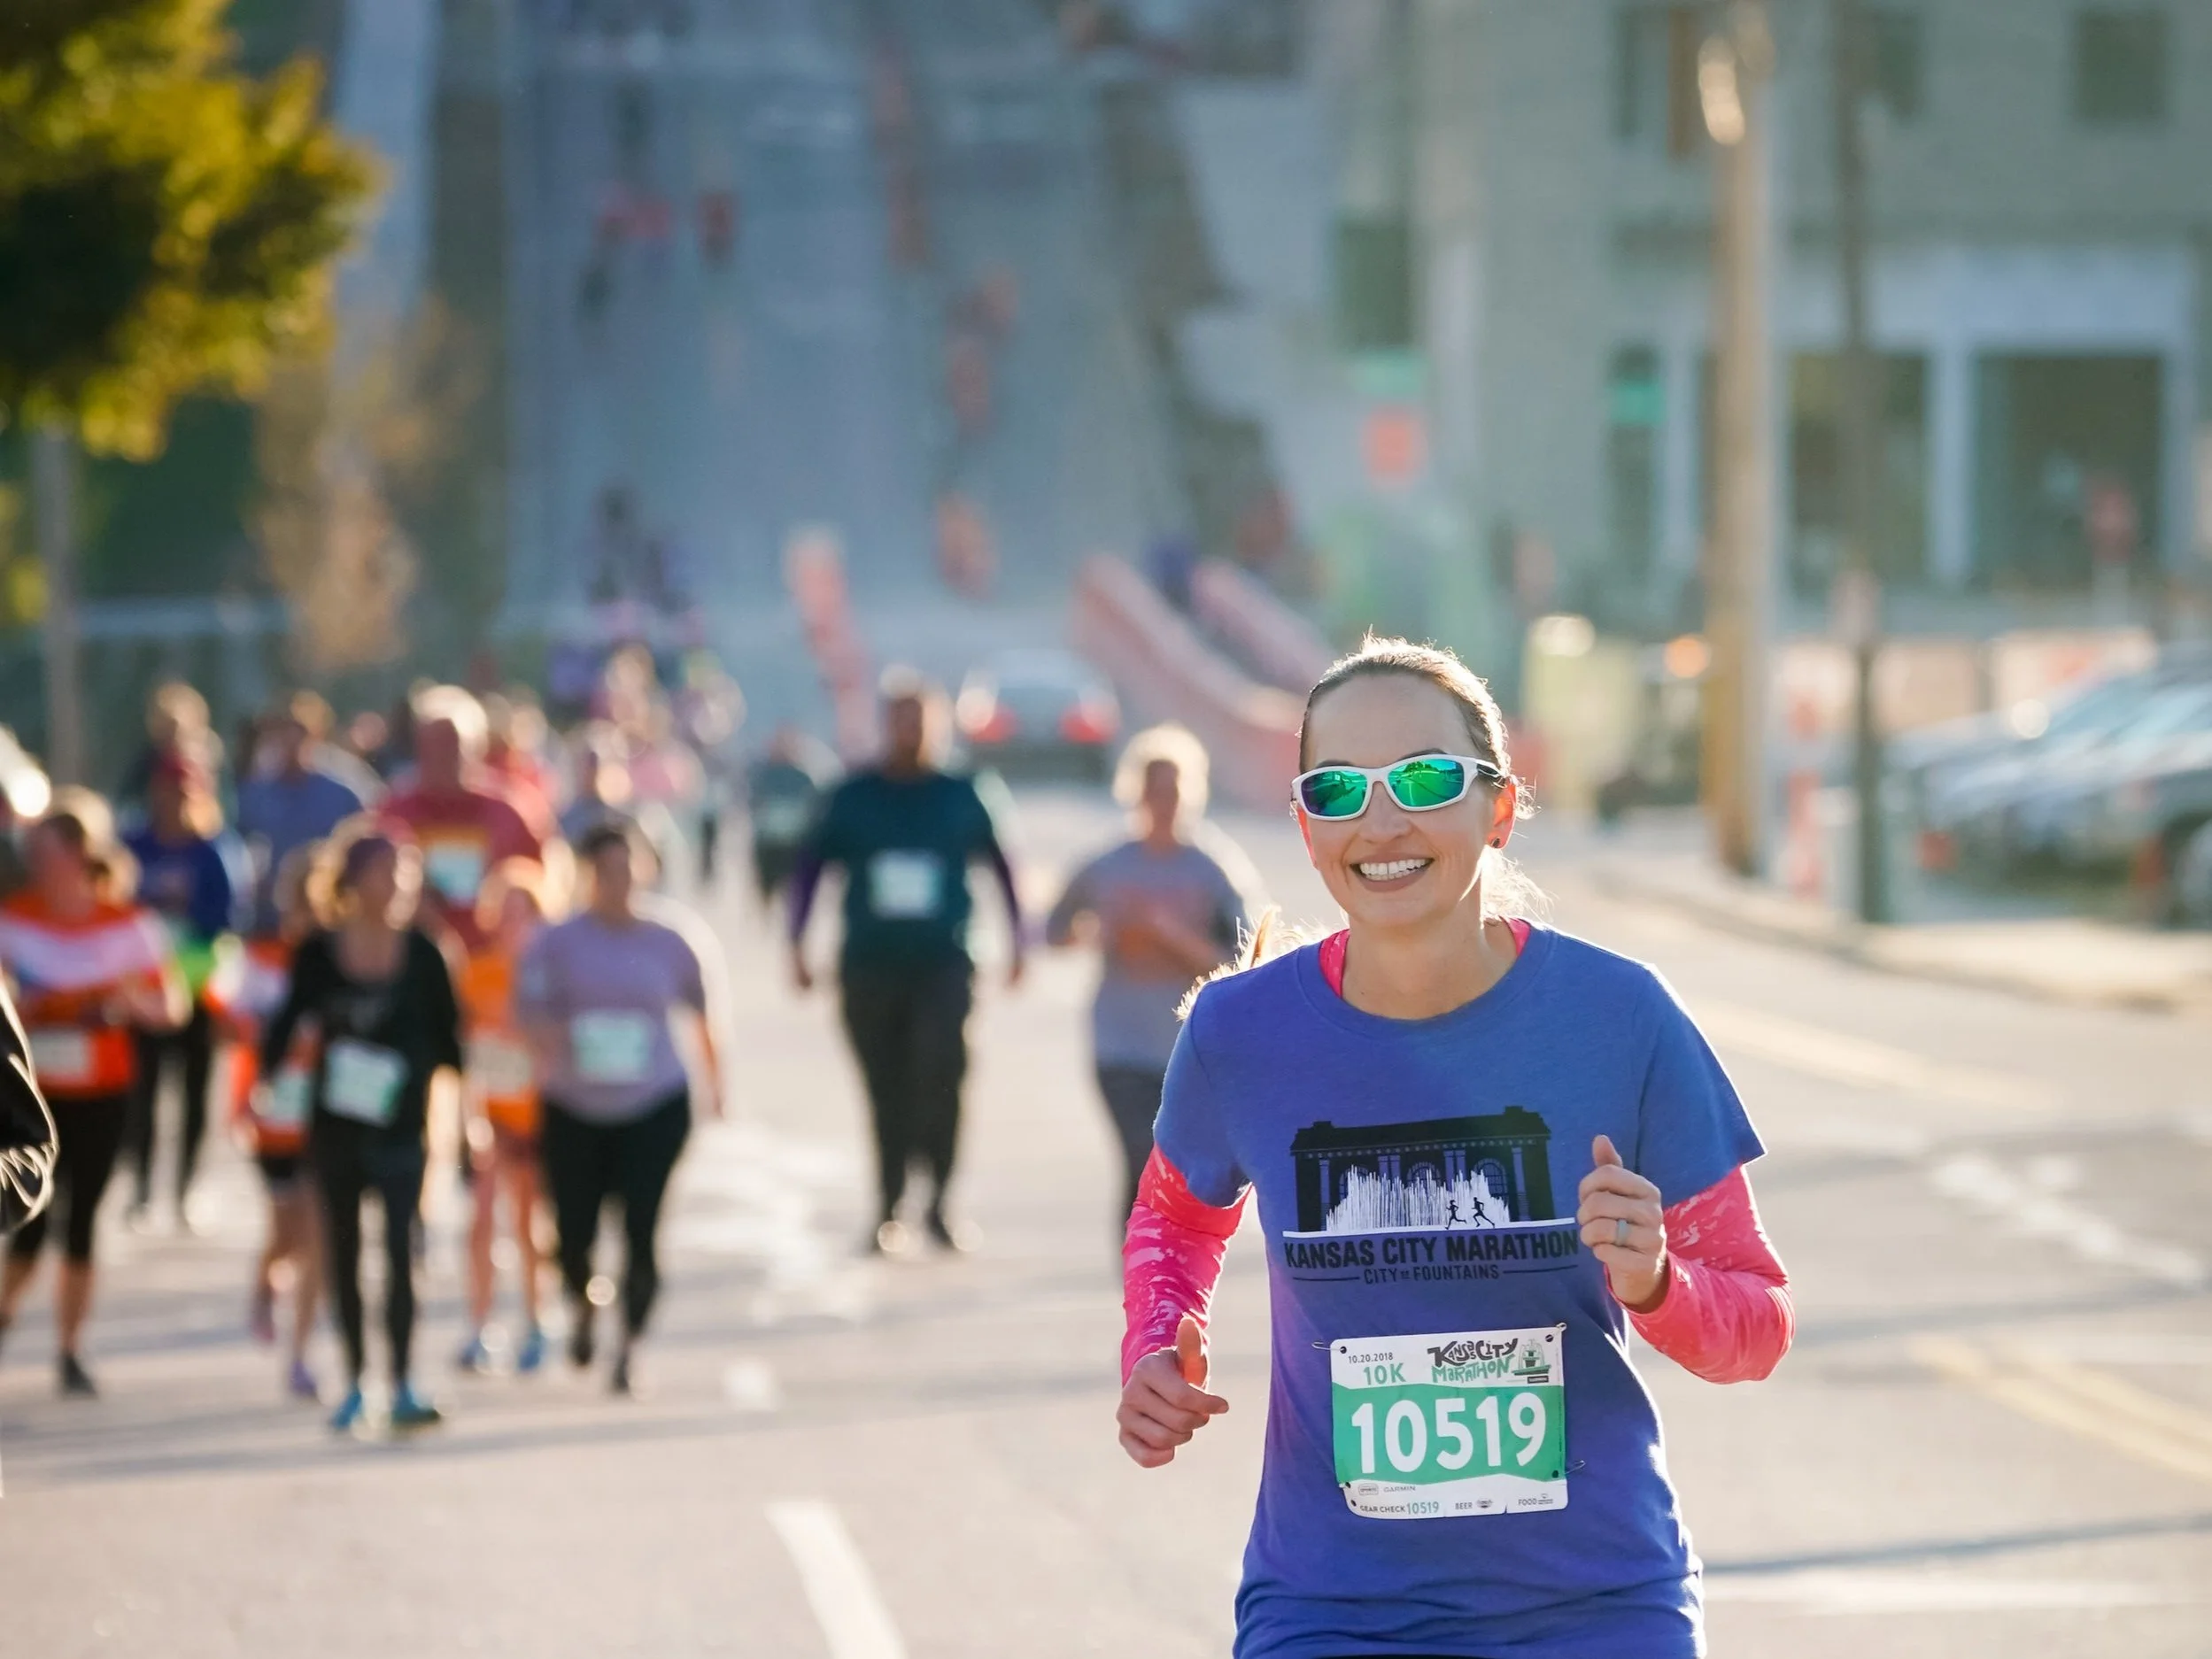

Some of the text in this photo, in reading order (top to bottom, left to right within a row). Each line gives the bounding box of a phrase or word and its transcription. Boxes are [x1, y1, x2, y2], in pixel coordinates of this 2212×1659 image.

[1284, 1229, 1579, 1269] KANSAS CITY MARATHON
[1364, 1267, 1397, 1285] CITY
[1413, 1264, 1500, 1282] FOUNTAINS
[1348, 1352, 1394, 1364] 10.20.2018
[1363, 1362, 1407, 1385] 10K
[1351, 1393, 1546, 1475] 10519
[1406, 1501, 1439, 1515] 10519
[1455, 1501, 1473, 1510] BEER
